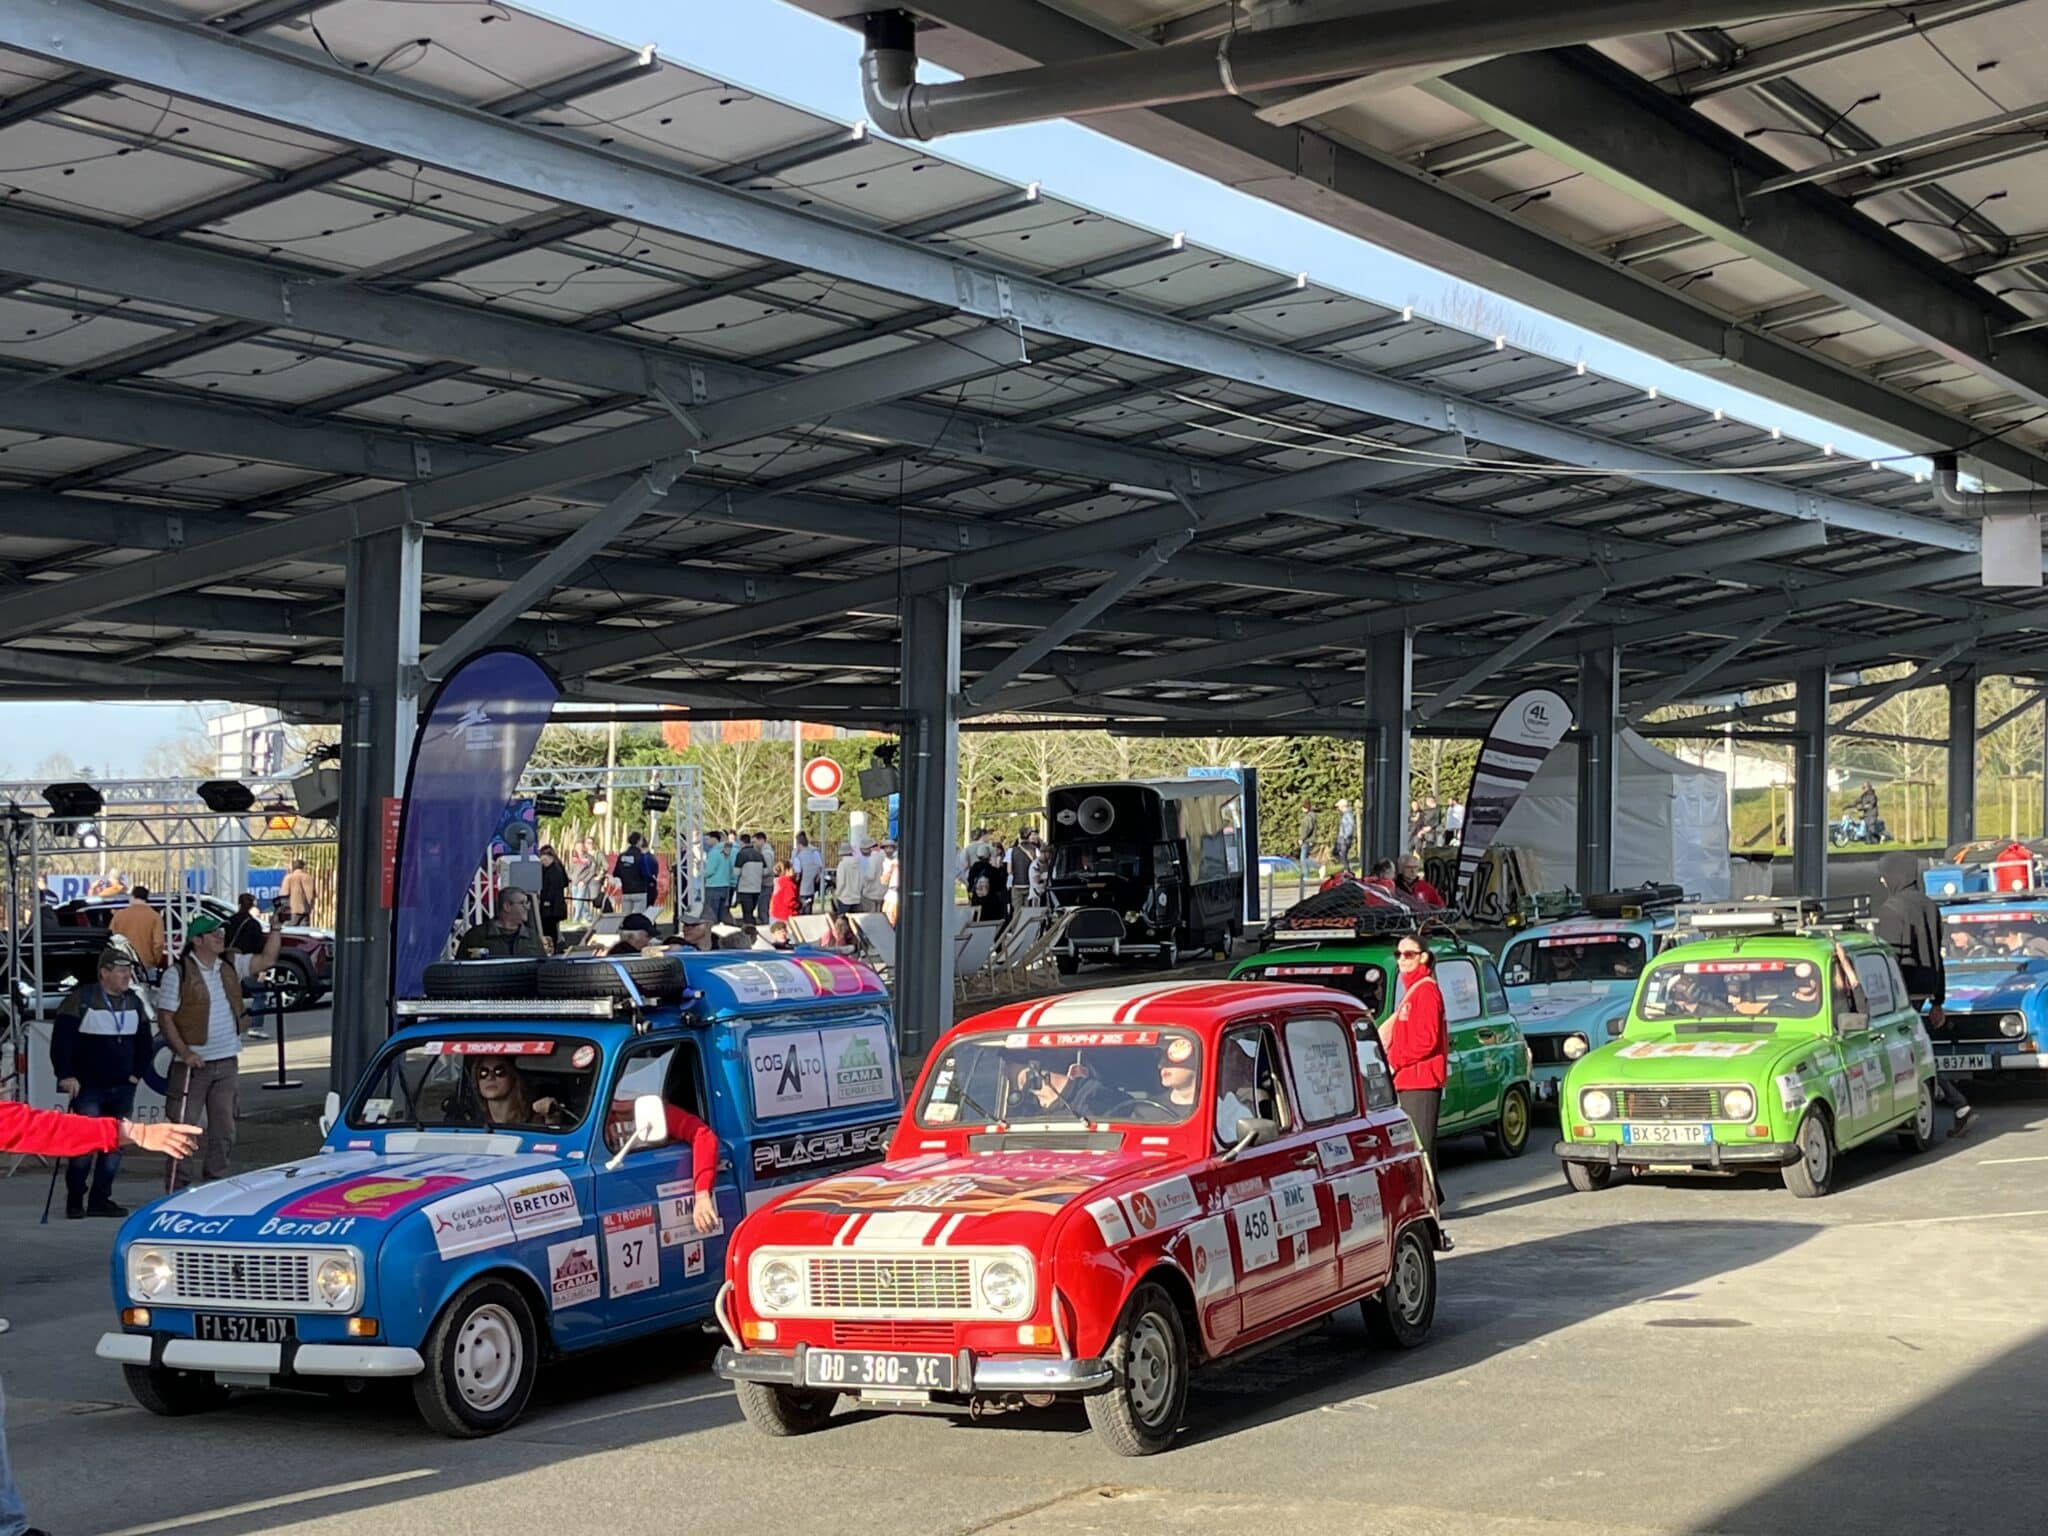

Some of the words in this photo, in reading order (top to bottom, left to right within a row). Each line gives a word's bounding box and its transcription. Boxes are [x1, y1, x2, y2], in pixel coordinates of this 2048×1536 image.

[1530, 705, 1549, 720] 4L
[1943, 1056, 1965, 1069] 837
[840, 1069, 879, 1082] GAMA
[1632, 1128, 1648, 1140] BX
[1654, 1128, 1677, 1141] 521
[1684, 1127, 1700, 1140] TP
[513, 1190, 570, 1215] BRETON
[676, 1198, 694, 1217] RM
[148, 1212, 231, 1234] Merci
[1245, 1211, 1269, 1241] 458
[622, 1241, 643, 1268] 37
[555, 1274, 596, 1291] GAMA
